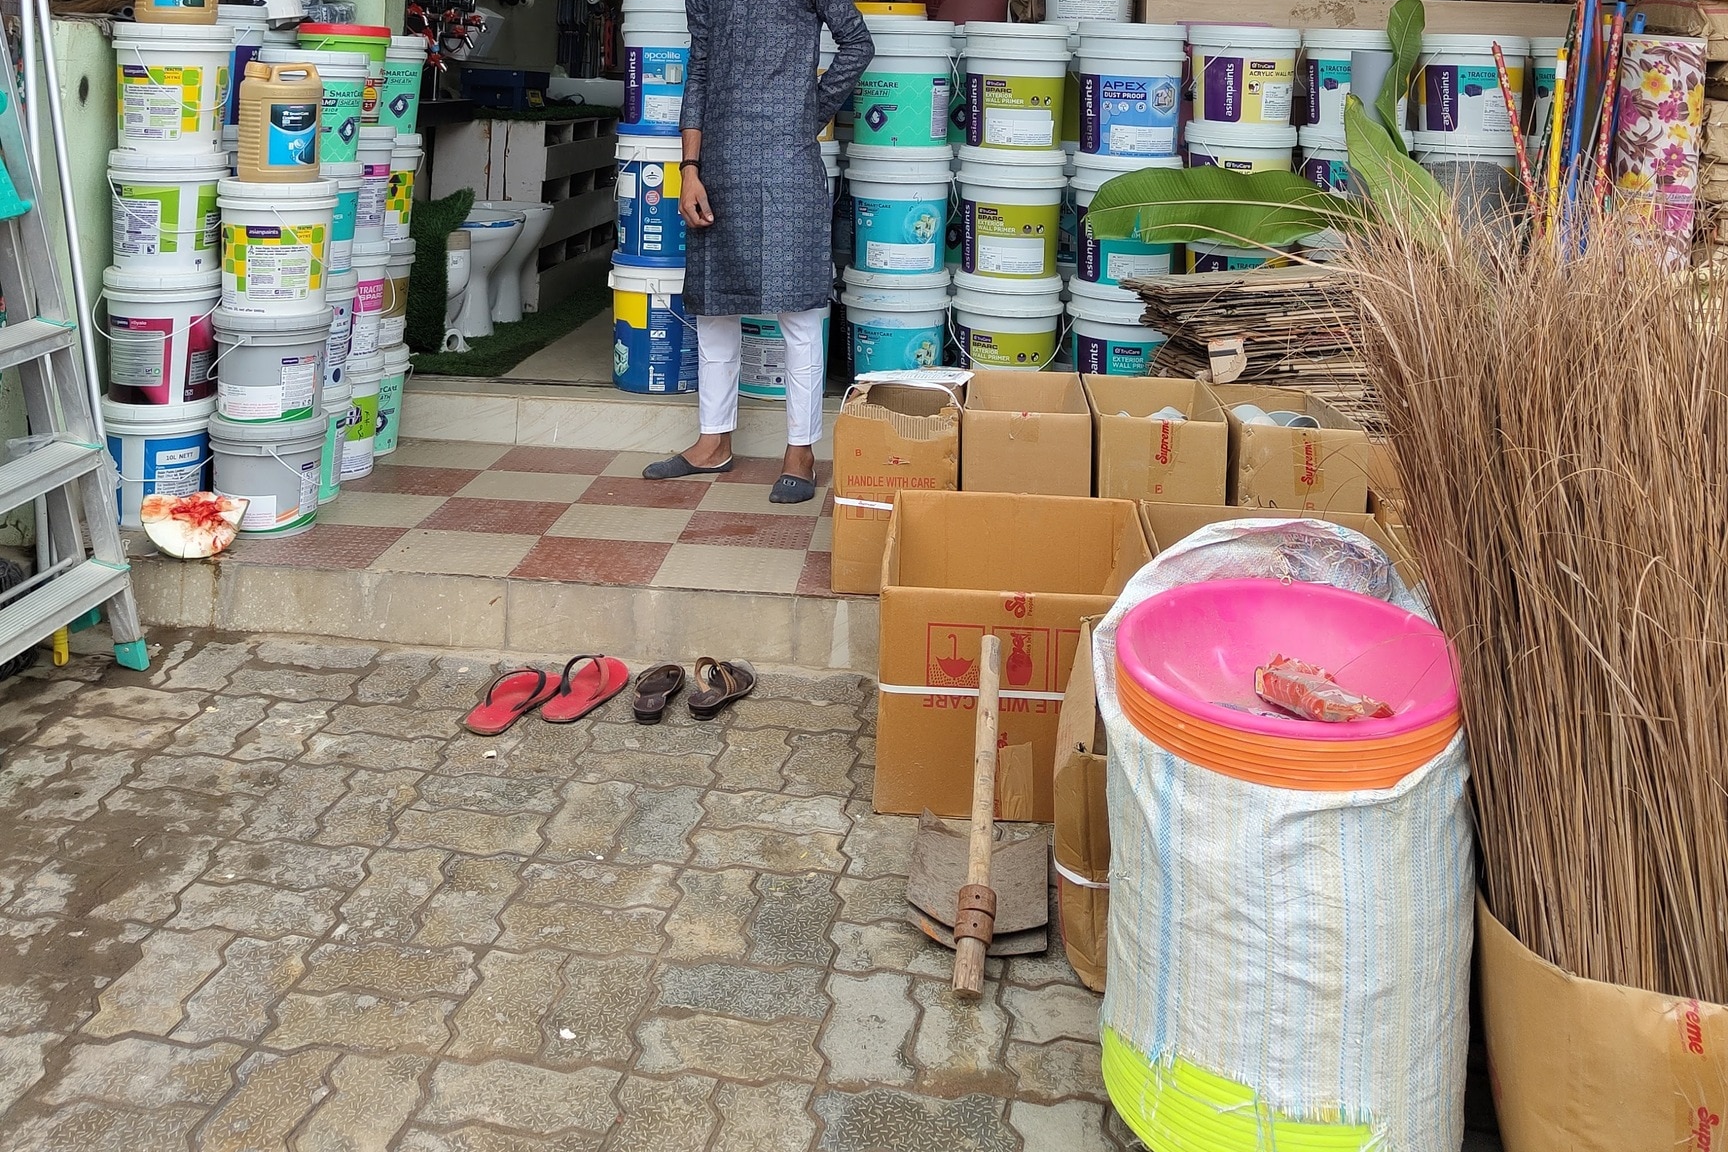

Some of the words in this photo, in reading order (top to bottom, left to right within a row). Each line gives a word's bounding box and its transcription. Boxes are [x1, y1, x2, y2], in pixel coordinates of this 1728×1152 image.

[971, 78, 980, 142] asianpaints
[1103, 80, 1147, 90] APEX
[1224, 63, 1237, 117] asianpaints
[1309, 65, 1317, 119] asianpaints
[1441, 71, 1453, 125] asianpaints
[1085, 79, 1096, 149] asianpaints
[964, 204, 973, 269] asianpaints
[178, 451, 194, 459] NETT
[855, 449, 862, 457] B
[847, 475, 884, 487] HANDLE
[886, 476, 909, 488] WITH
[910, 477, 936, 488] CARE
